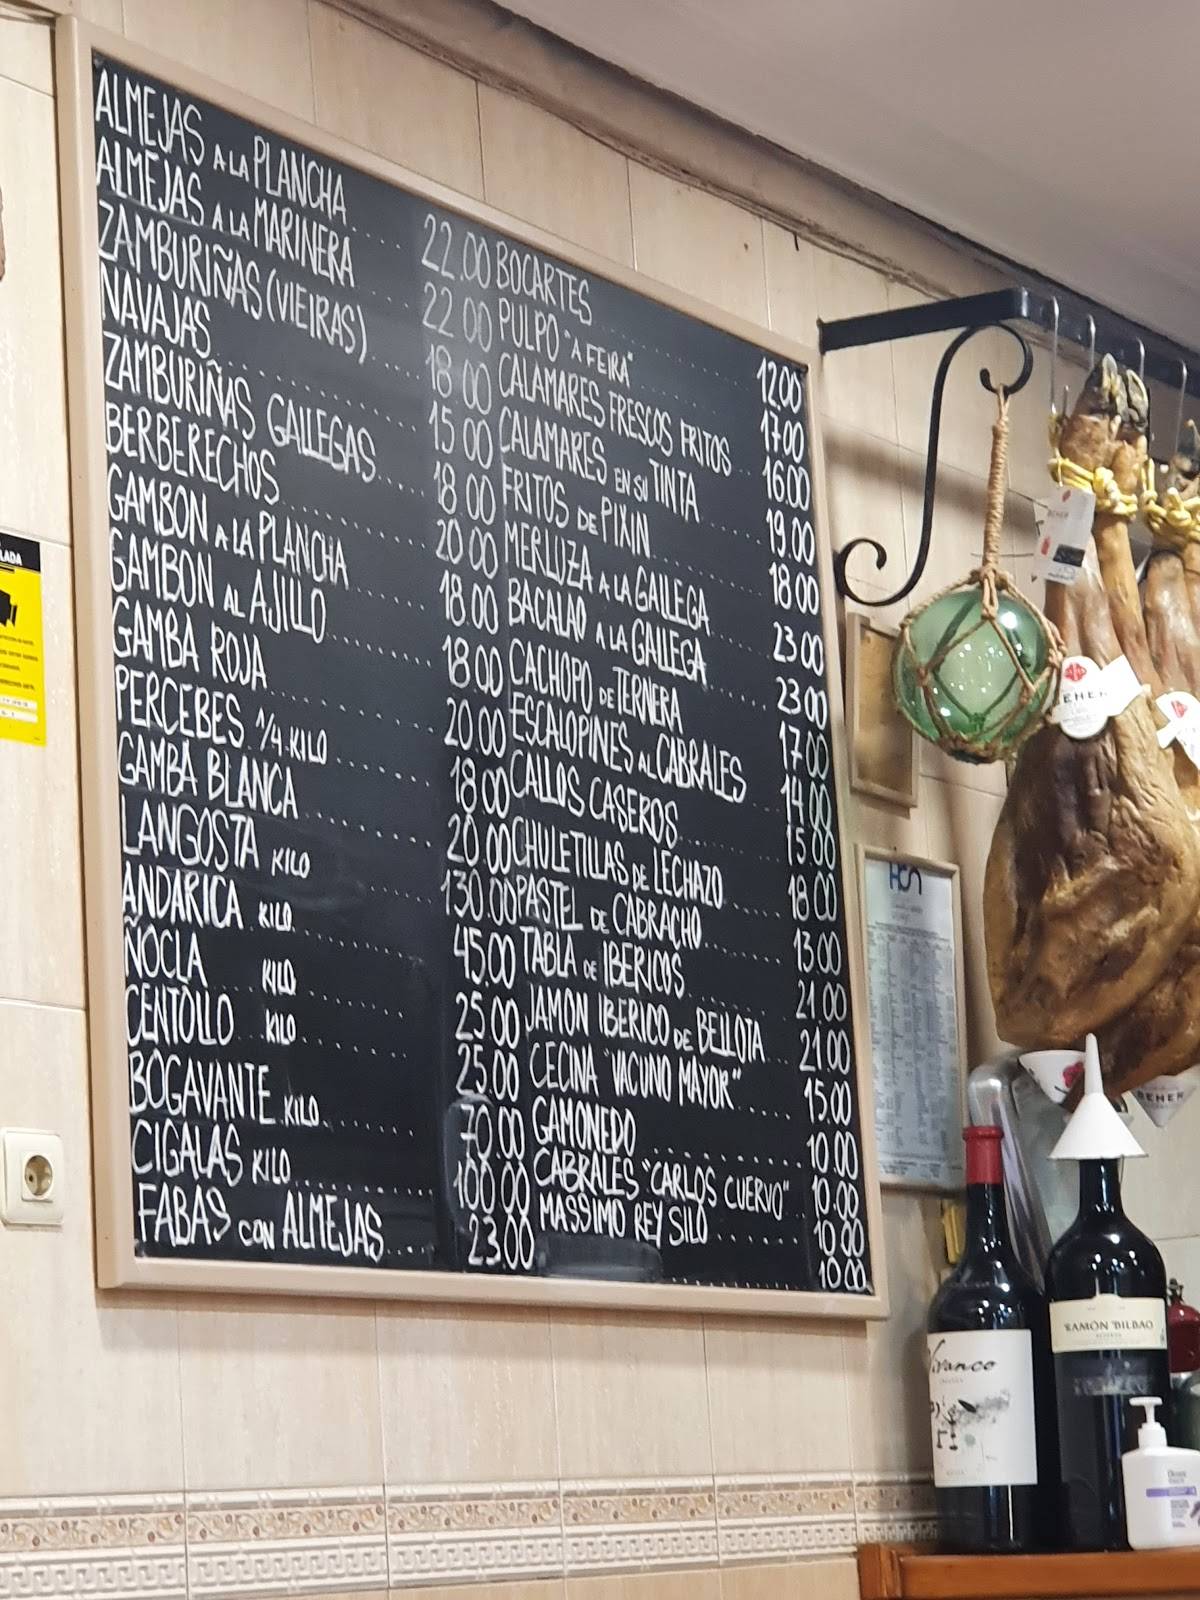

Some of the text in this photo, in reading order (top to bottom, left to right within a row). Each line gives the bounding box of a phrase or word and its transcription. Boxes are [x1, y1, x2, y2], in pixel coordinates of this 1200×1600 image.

[95, 68, 491, 289] ALMEJAS A LA PLANCHA 22.00
[95, 135, 204, 226] ALMEJAS
[212, 203, 224, 232] A
[229, 210, 250, 240] LA
[253, 197, 354, 288] MARINERA
[100, 261, 211, 358] NAVAJAS
[496, 241, 592, 326] BOCARTES
[499, 298, 559, 362] PULPO
[103, 330, 256, 440] ZAMBURIÑAS
[267, 393, 376, 482] GALLEGAS
[105, 401, 279, 505] BERBERECHOS
[500, 352, 606, 428] CALAMARES
[609, 391, 673, 457] FRESCOS
[680, 418, 731, 477] FRITOS
[499, 406, 607, 485] CALAMARES
[614, 467, 630, 496] EN
[633, 474, 648, 502] SU
[649, 458, 700, 524] TINTA
[502, 463, 569, 528] FRITOS
[577, 505, 599, 535] DE
[602, 496, 650, 558] PIXIN
[107, 463, 208, 546] GAMBON
[215, 524, 228, 551] A
[233, 518, 254, 559] LA
[259, 510, 349, 590] PLANCHA
[109, 526, 214, 608] GAMBON
[223, 583, 245, 617] AL
[250, 568, 326, 643] AJILLO
[505, 520, 593, 594] MERLUZA
[599, 571, 610, 600] A
[614, 574, 632, 606] LA
[635, 565, 710, 637] GALLEGA
[112, 596, 199, 672] GAMBA
[211, 621, 267, 691] ROJA
[508, 578, 587, 642] BACALAO
[610, 624, 628, 654] LA
[631, 618, 707, 689] GALLEGA
[115, 664, 244, 749] PERCEBES
[289, 726, 327, 765] KILO
[509, 638, 592, 714] CACHOPO
[599, 687, 615, 709] DE
[612, 666, 683, 734] TERNERA
[117, 731, 198, 797] GAMBA
[207, 747, 298, 819] BLANCA
[509, 691, 633, 774] ESCALOPINES
[638, 751, 657, 780] AL
[656, 733, 746, 803] CABRALES
[510, 749, 585, 817] CALLOS
[589, 776, 678, 849] CASEROS
[121, 794, 517, 926] LANGOSTA KILO 130.00
[512, 815, 629, 885] CHULETILLAS
[632, 862, 649, 892] DE
[653, 847, 723, 910] LECHAZO
[122, 861, 516, 990] ANDARICA KILO 45.00
[124, 916, 208, 988] ÑOCLA
[262, 959, 296, 995] KILO
[516, 872, 583, 931] PASTEL
[590, 906, 610, 934] DE
[613, 892, 702, 950] CABRACHO
[519, 926, 577, 977] TABLA
[583, 959, 597, 981] DE
[603, 940, 685, 999] IBERICOS
[125, 983, 234, 1047] CENTOLLO
[265, 1009, 296, 1045] KILO
[525, 982, 589, 1037] JAMON
[598, 992, 669, 1047] IBERICO
[674, 1028, 694, 1051] DE
[696, 1007, 765, 1064] BELLOTA
[129, 1048, 275, 1124] BOGAVANTE
[284, 1095, 319, 1127] KILO
[530, 1041, 599, 1097] CECINA
[131, 1118, 243, 1187] CIGALAS
[252, 1147, 291, 1184] KILO
[532, 1095, 636, 1157] GAMONEDO
[533, 1147, 639, 1200] CABRALES
[138, 1182, 231, 1247] FABAS
[283, 1190, 384, 1262] ALMEJAS
[539, 1192, 626, 1239] MASSIMO
[635, 1200, 662, 1249] REY
[668, 1203, 708, 1246] SILO
